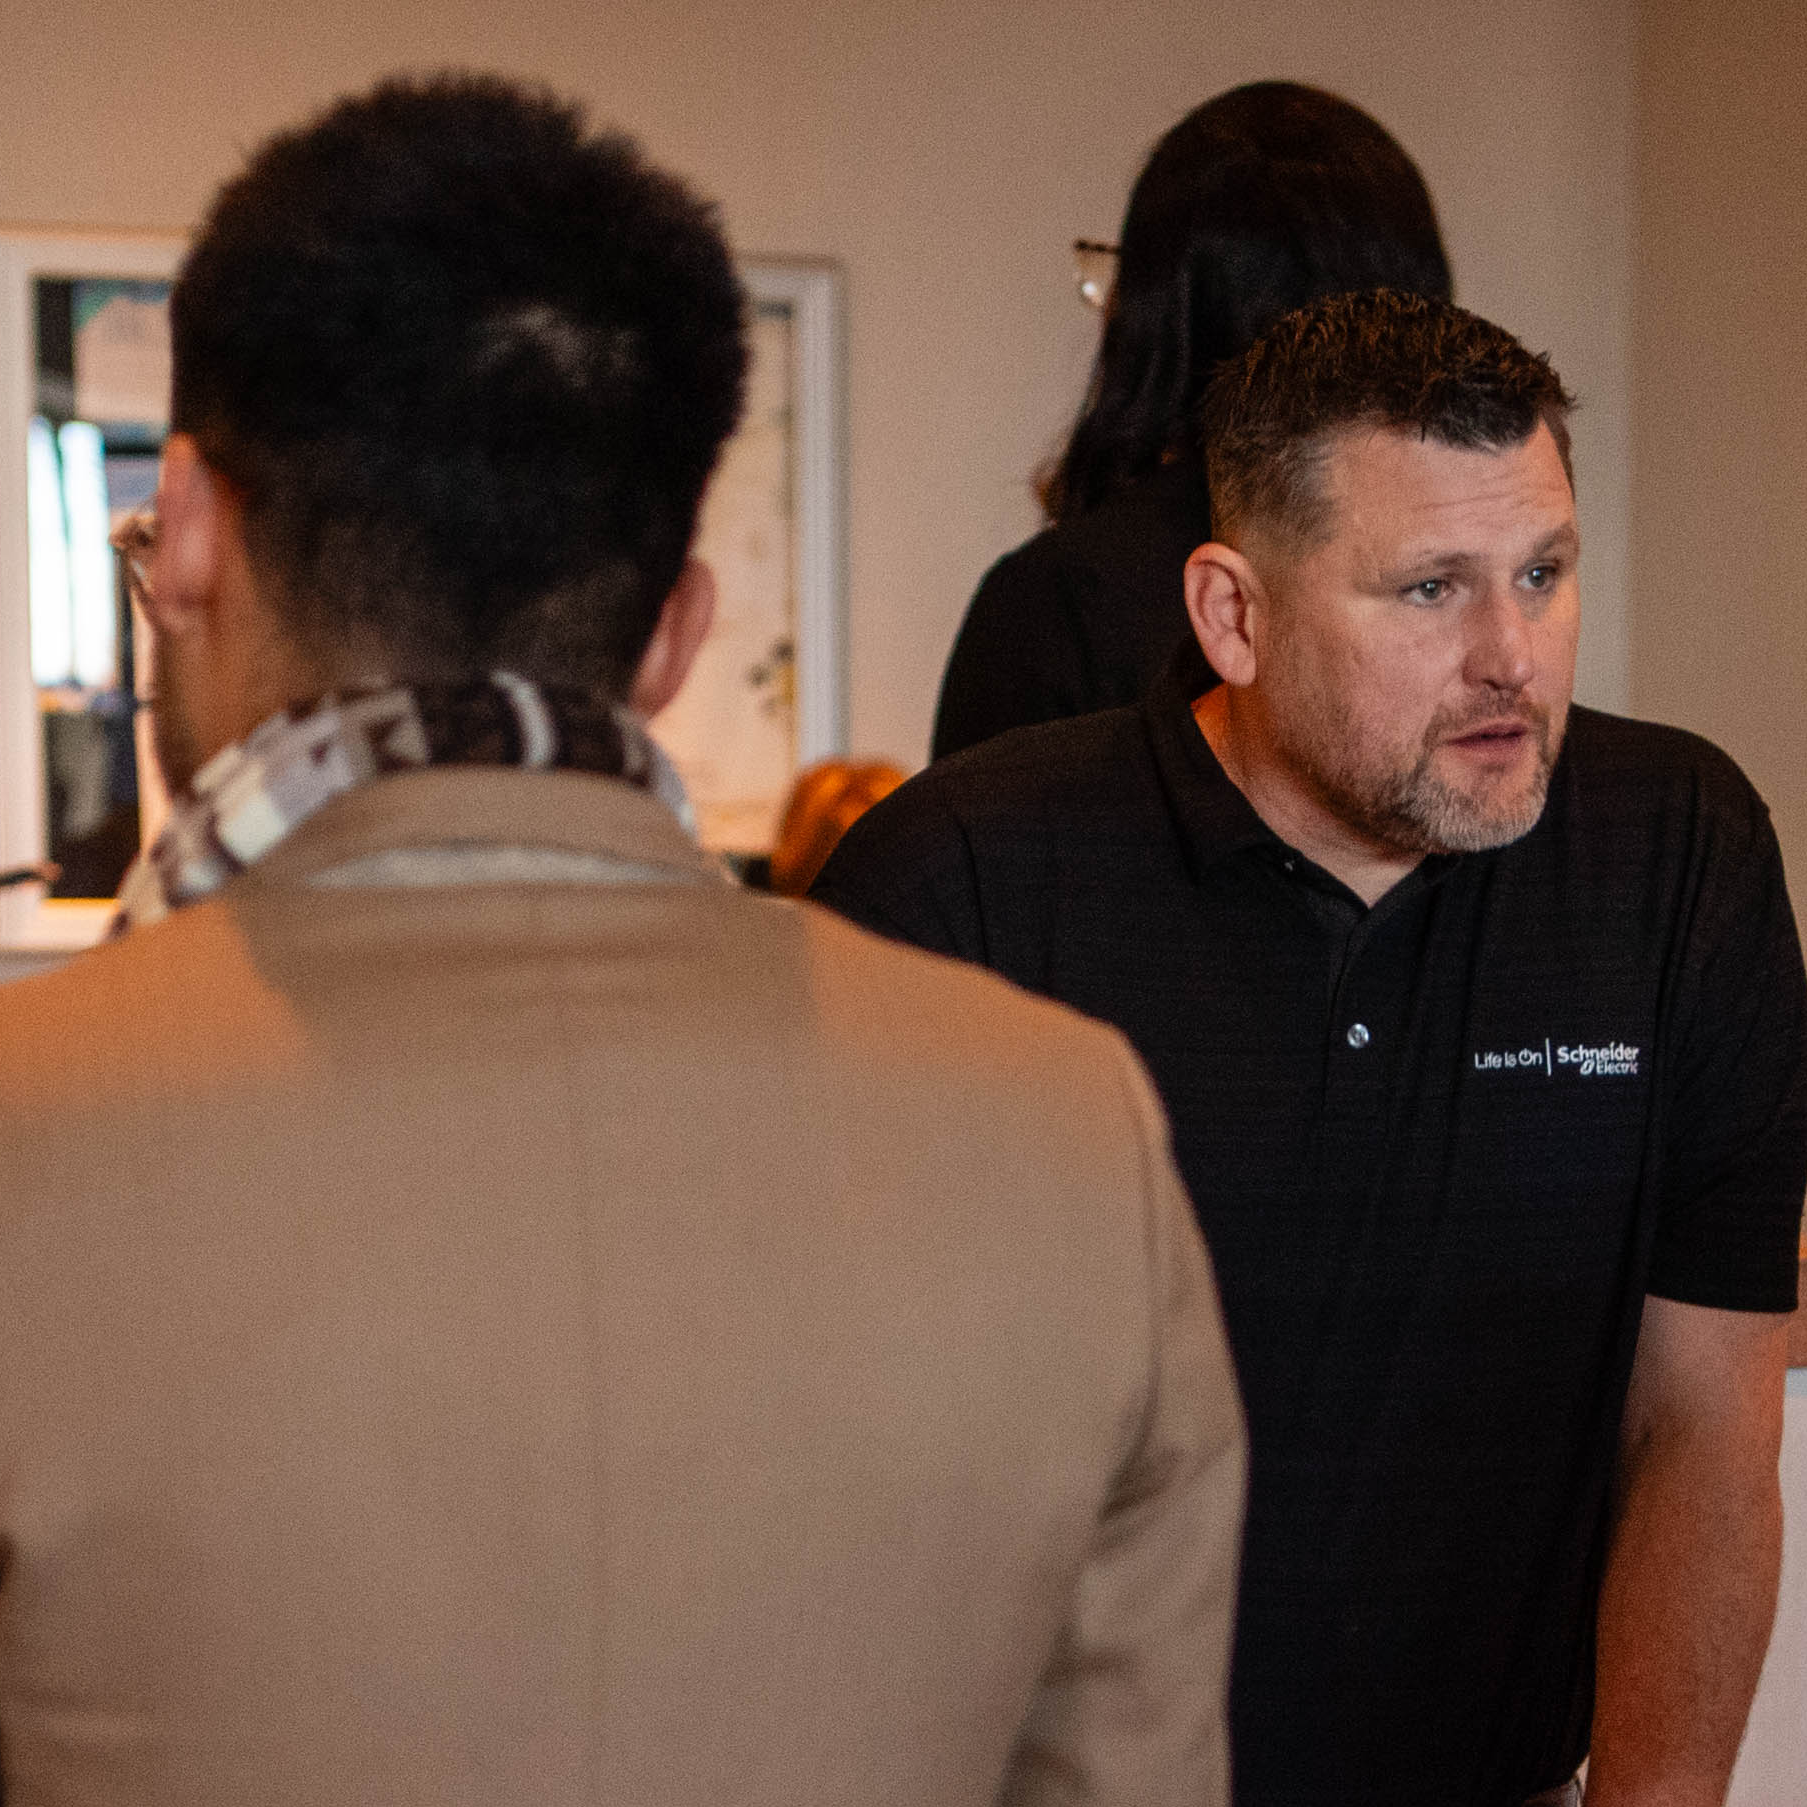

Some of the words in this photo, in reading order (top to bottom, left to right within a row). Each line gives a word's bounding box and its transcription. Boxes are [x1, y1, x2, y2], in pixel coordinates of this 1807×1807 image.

[1474, 1052, 1502, 1070] Life
[1518, 1048, 1543, 1067] On
[1556, 1041, 1640, 1065] Schneider
